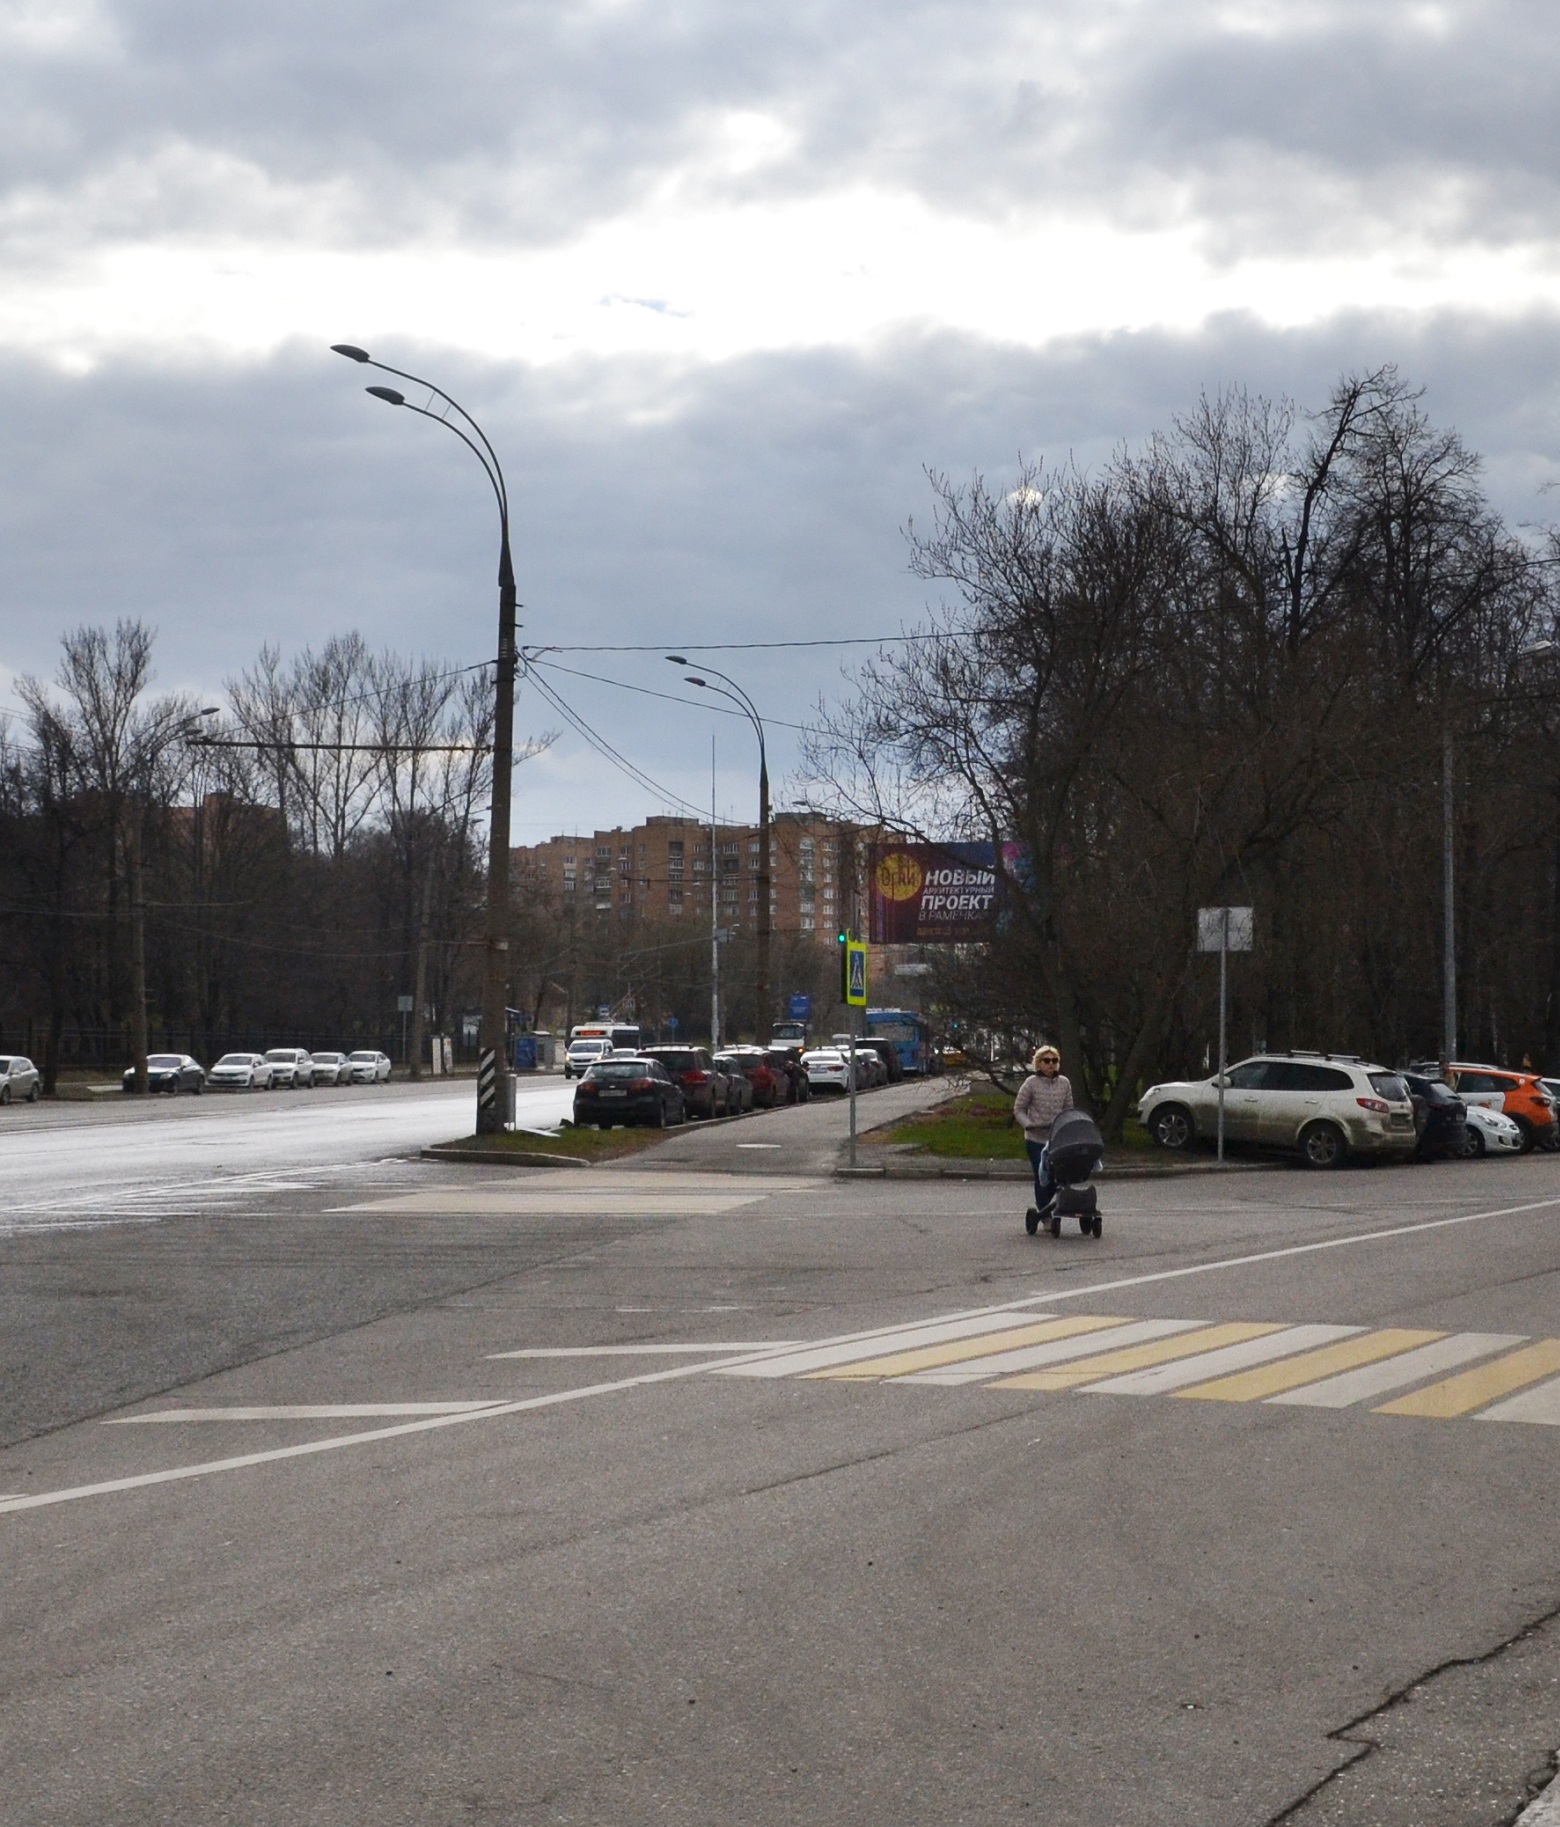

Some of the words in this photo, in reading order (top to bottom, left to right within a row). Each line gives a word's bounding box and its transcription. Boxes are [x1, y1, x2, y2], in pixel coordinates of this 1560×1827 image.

[925, 865, 996, 886] НОВЫЙ
[921, 895, 993, 910] ПРОЕКТ
[918, 911, 926, 921] В
